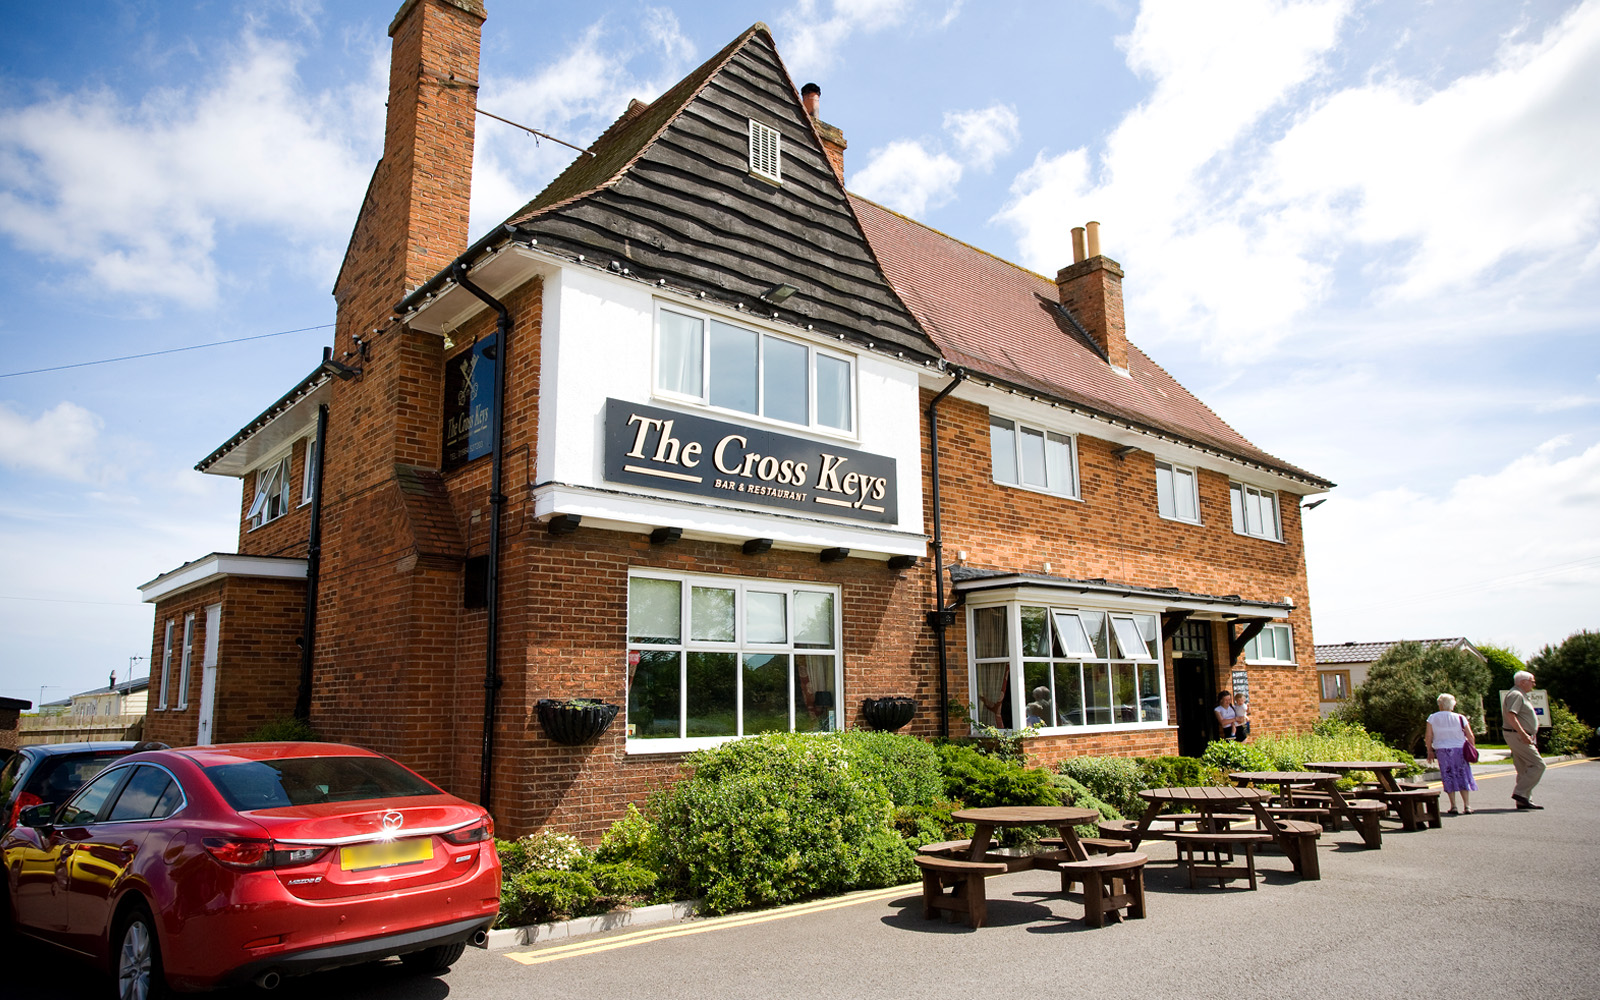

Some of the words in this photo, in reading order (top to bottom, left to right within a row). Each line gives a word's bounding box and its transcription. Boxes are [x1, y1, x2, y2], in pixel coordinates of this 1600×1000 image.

[447, 416, 458, 439] The
[474, 403, 489, 430] Keys
[626, 413, 703, 468] The
[713, 434, 808, 487] Cross
[815, 453, 887, 508] Keys
[714, 479, 736, 490] BAR
[738, 483, 745, 492] &
[747, 484, 808, 502] RESTAURANT
